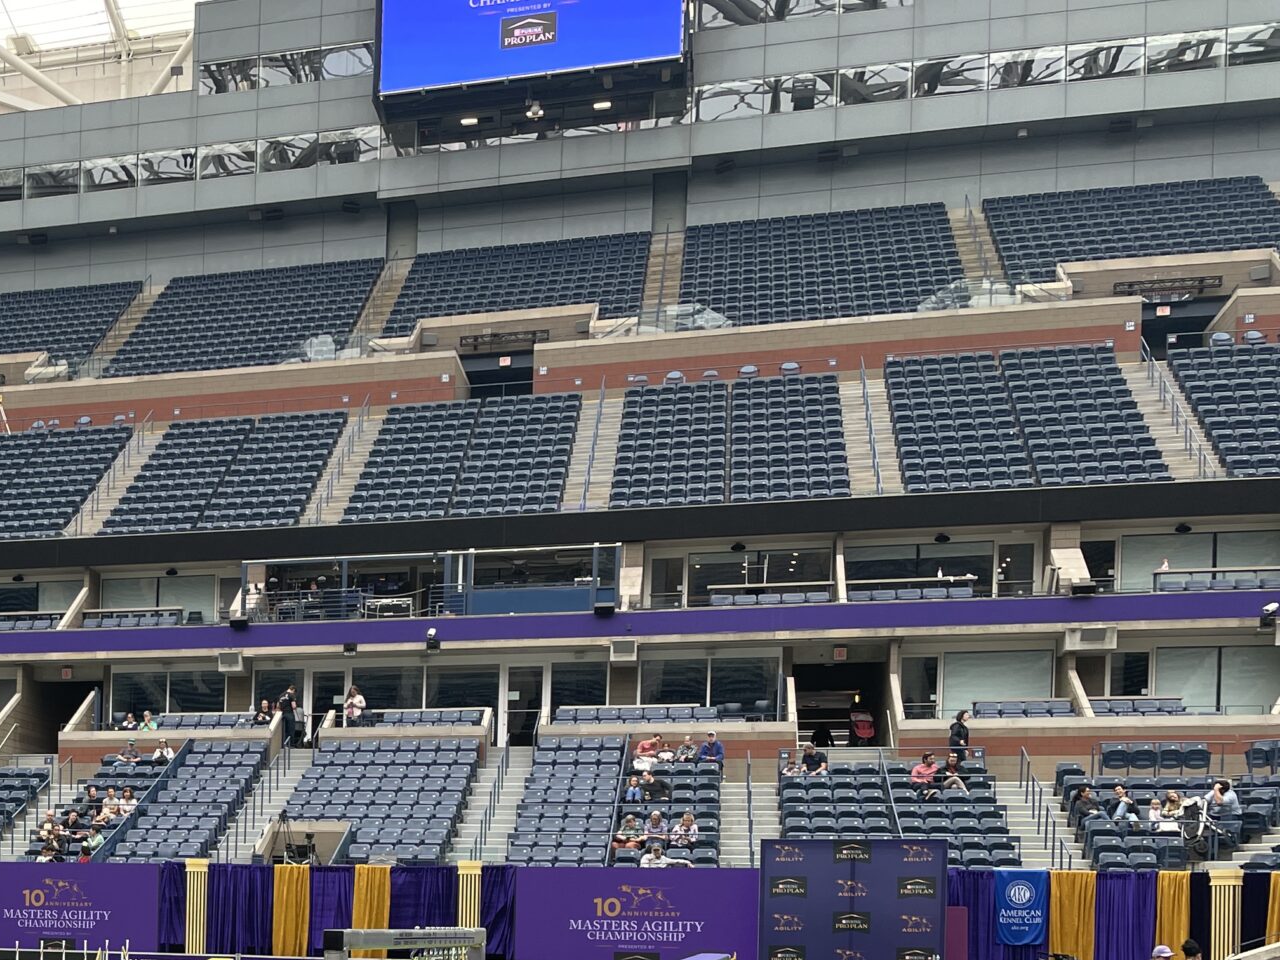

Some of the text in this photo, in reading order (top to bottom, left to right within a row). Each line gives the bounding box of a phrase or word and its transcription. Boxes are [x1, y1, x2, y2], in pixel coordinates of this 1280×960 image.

[505, 32, 554, 45] PRO PLAN
[3, 909, 111, 920] MASTERS AGILITY
[1000, 909, 1041, 917] AMERICAN
[18, 919, 96, 929] CHAMPIONSHIP
[569, 920, 705, 932] MASTERS AGILITY
[587, 931, 685, 941] CHAMPIONSHIP
